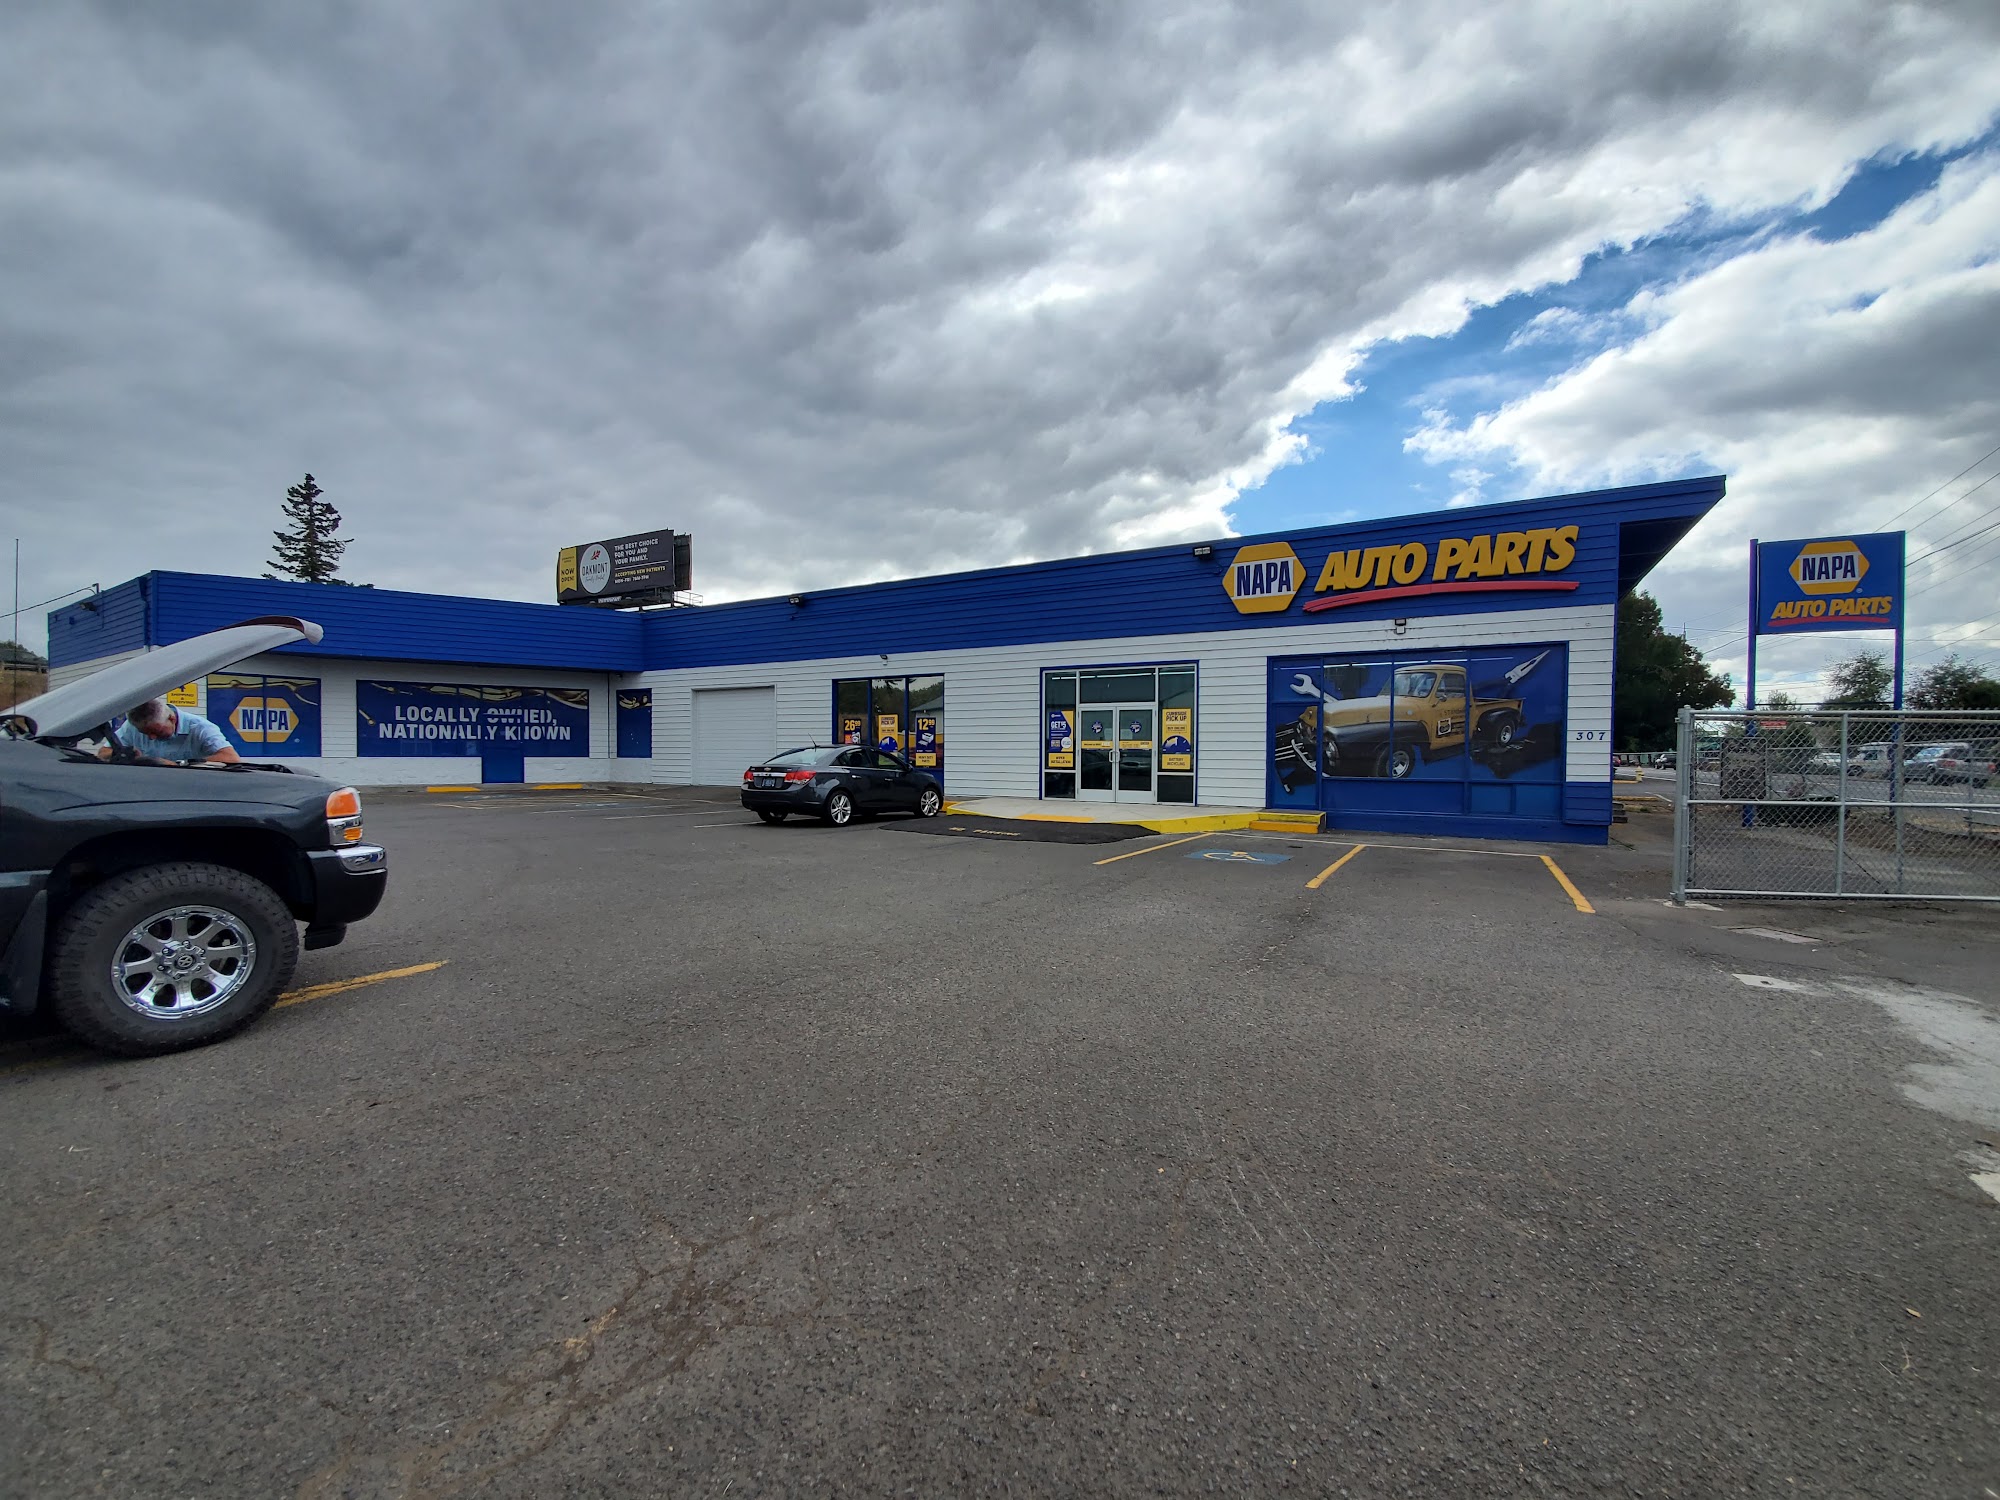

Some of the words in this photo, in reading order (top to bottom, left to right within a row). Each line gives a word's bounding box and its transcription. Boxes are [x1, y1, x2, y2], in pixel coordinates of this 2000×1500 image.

[625, 542, 638, 550] BEST
[639, 538, 659, 547] CHOICE
[637, 547, 648, 555] AND
[614, 557, 629, 565] YOUR
[1313, 542, 1428, 592] AUTO
[1431, 525, 1579, 581] PARTS
[560, 568, 575, 576] NOW
[581, 562, 608, 576] OAKMONT
[1802, 554, 1856, 581] NAPA
[1236, 560, 1292, 597] NAPA
[1770, 600, 1827, 619] AUTO
[1828, 596, 1893, 616] PARTS
[241, 708, 289, 730] NAPA
[395, 706, 480, 722] LOCALLY
[1576, 731, 1606, 741] 307
